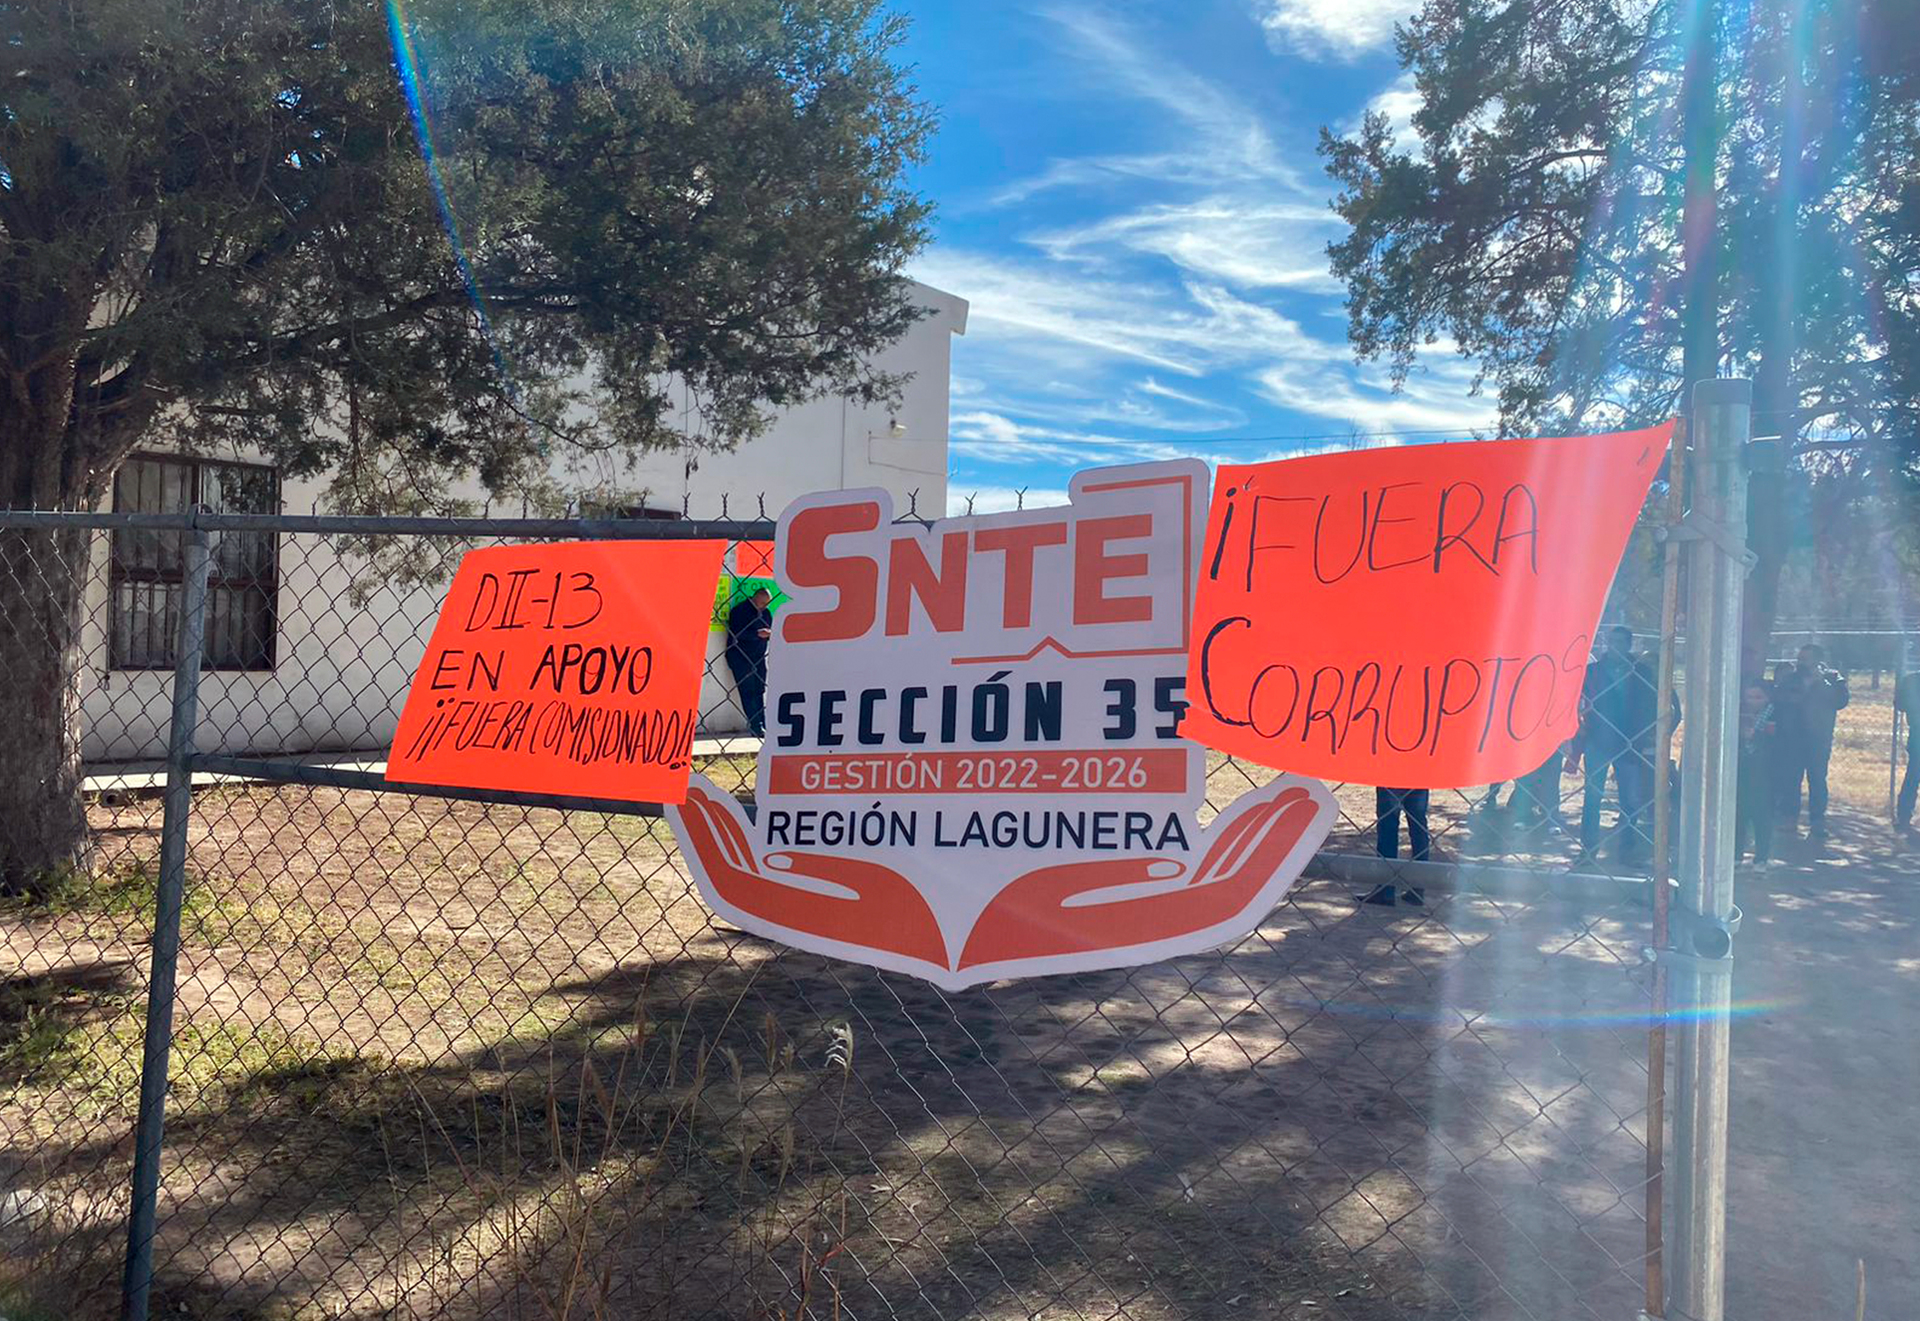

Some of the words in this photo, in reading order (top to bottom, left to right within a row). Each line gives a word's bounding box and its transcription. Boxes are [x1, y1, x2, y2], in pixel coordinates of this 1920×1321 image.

[782, 501, 1153, 643] SNTE
[431, 650, 505, 691] EN
[529, 644, 652, 696] APOYO
[1202, 616, 1588, 756] CORRUPTOS
[777, 670, 1063, 747] SECCIÓN
[1103, 677, 1190, 740] 35
[801, 752, 943, 790] GESTIÓN
[956, 756, 1148, 789] 2022-2026
[767, 801, 917, 846] REGIÓN
[934, 810, 1190, 852] LAGUNERA
